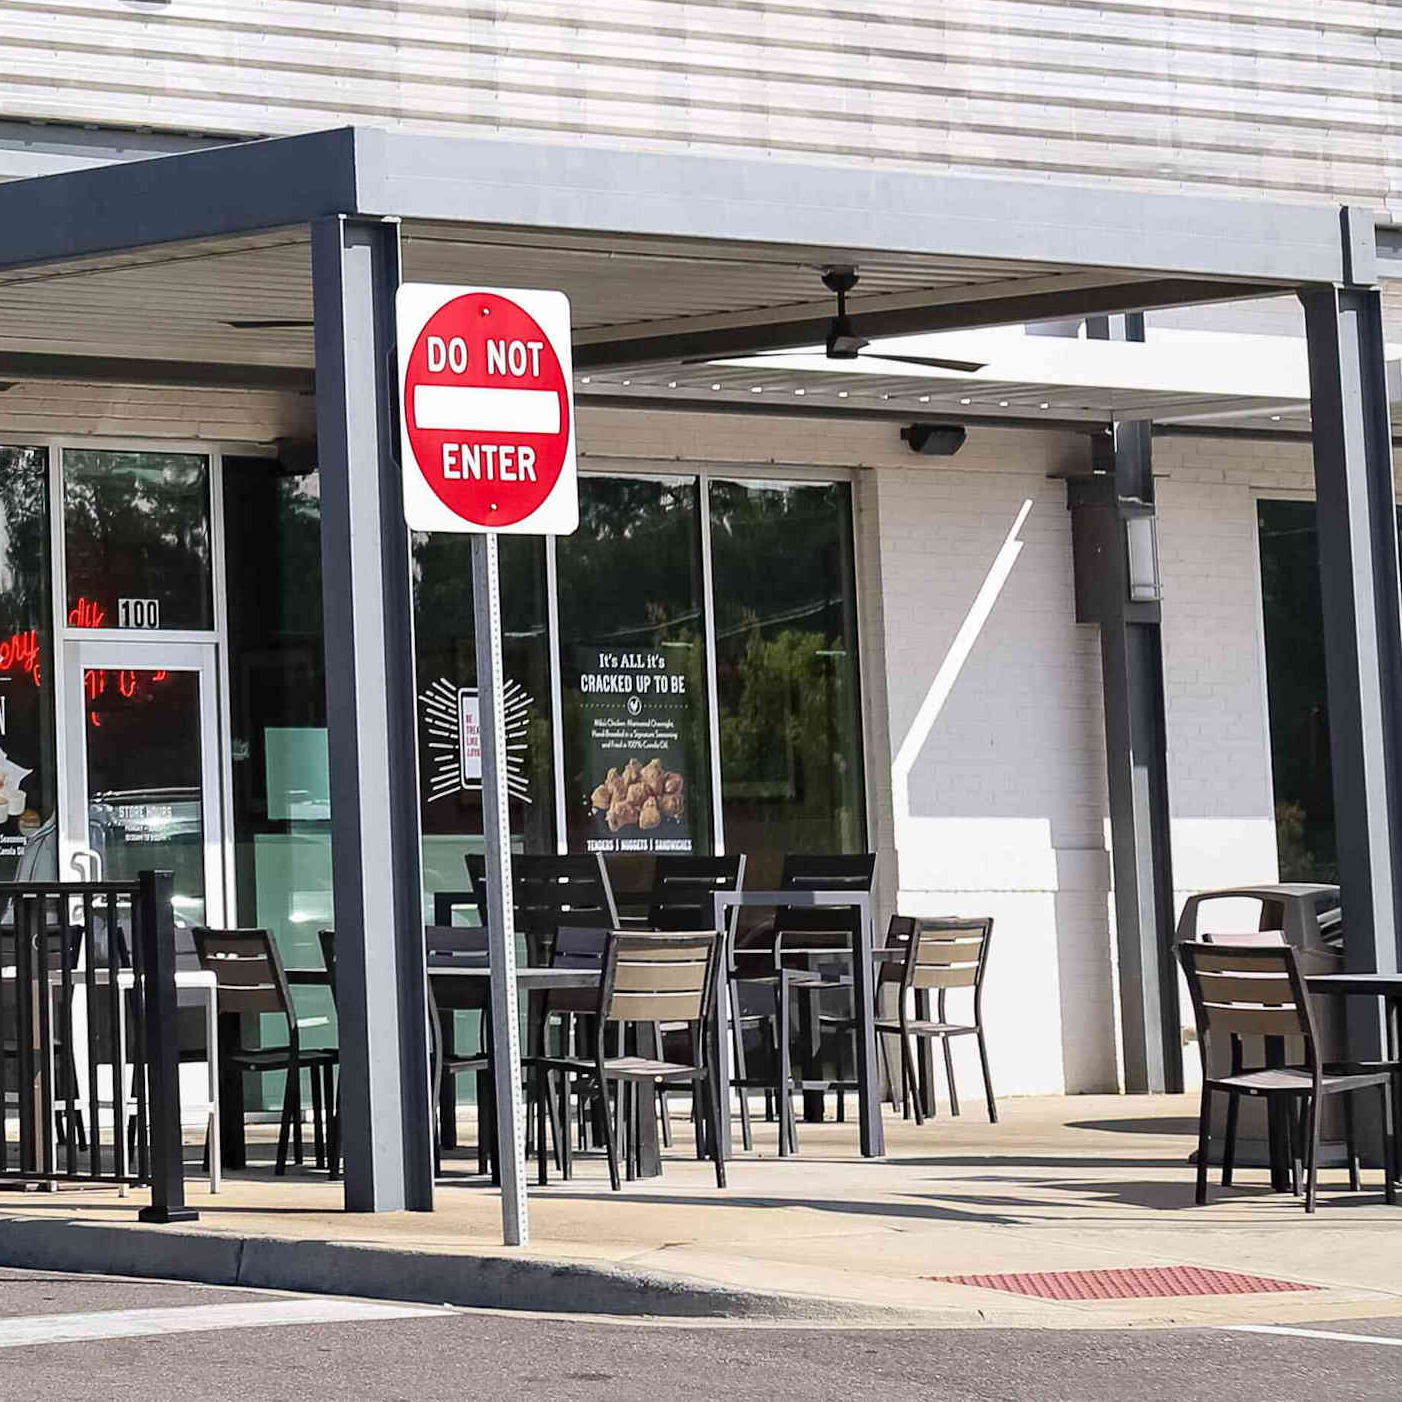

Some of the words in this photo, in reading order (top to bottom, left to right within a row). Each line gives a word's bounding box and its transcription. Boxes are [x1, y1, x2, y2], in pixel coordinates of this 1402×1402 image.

[427, 336, 469, 374] DO
[486, 339, 544, 377] NOT
[442, 442, 538, 482] ENTER
[120, 600, 159, 629] 100
[599, 653, 618, 669] It's
[620, 653, 645, 669] ALL
[647, 653, 665, 669] it's
[580, 674, 633, 693] CRACKED
[636, 675, 651, 693] UP
[653, 675, 668, 694] TO
[671, 675, 685, 694] BE
